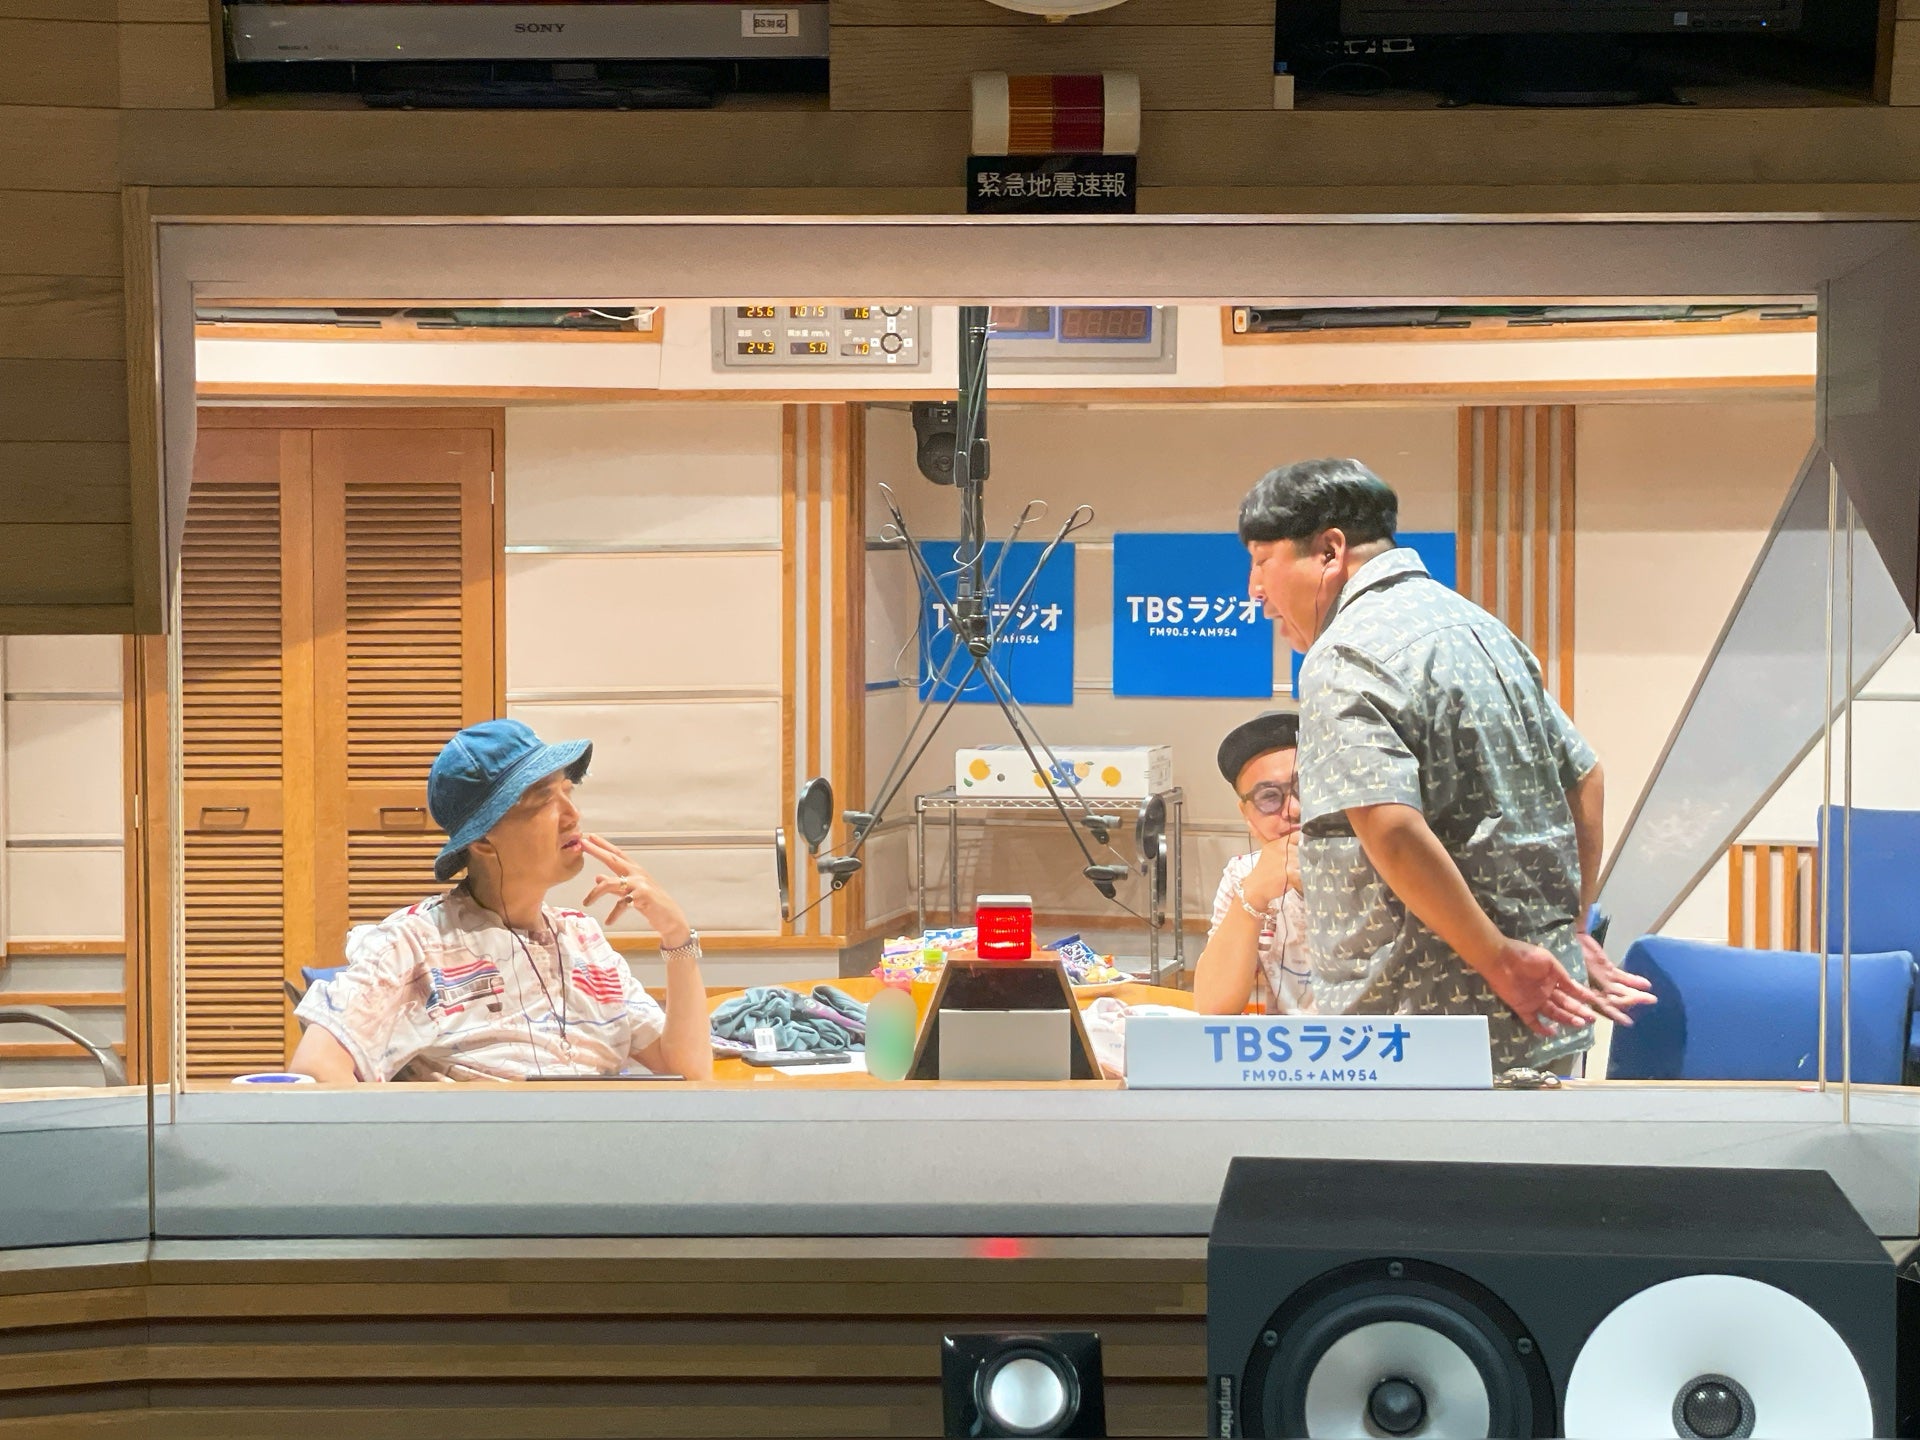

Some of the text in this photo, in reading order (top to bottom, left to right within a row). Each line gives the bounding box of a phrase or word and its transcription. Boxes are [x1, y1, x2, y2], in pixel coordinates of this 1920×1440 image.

[514, 23, 566, 33] SONY
[977, 172, 1126, 197] 緊急地震速報
[747, 342, 775, 353] 24.3
[809, 342, 828, 353] 5.0
[855, 342, 870, 355] 1.0
[932, 603, 1062, 631] Tラジオ
[1126, 596, 1262, 624] TBSラジオ
[1204, 1023, 1411, 1063] TBSラジオ
